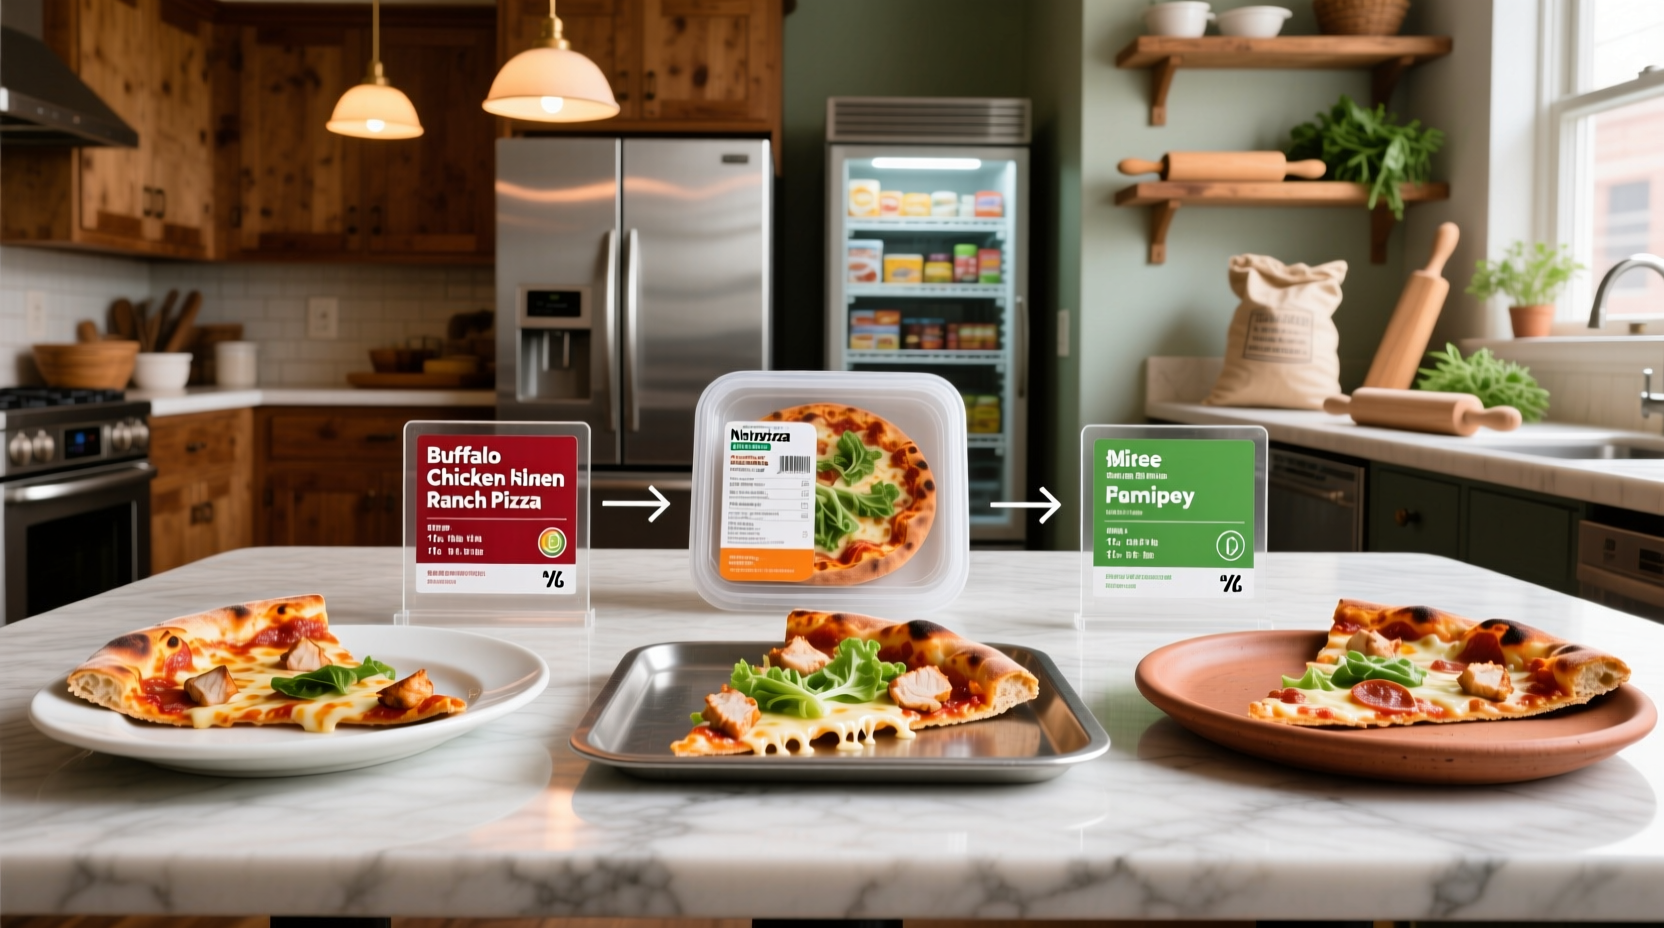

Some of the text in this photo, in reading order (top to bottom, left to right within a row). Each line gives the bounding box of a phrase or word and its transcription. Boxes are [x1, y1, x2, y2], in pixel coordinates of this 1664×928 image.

[427, 446, 501, 464] Buffalo
[1106, 449, 1162, 468] Miree
[427, 467, 506, 487] Chicken
[427, 490, 542, 510] Ranch Pizza
